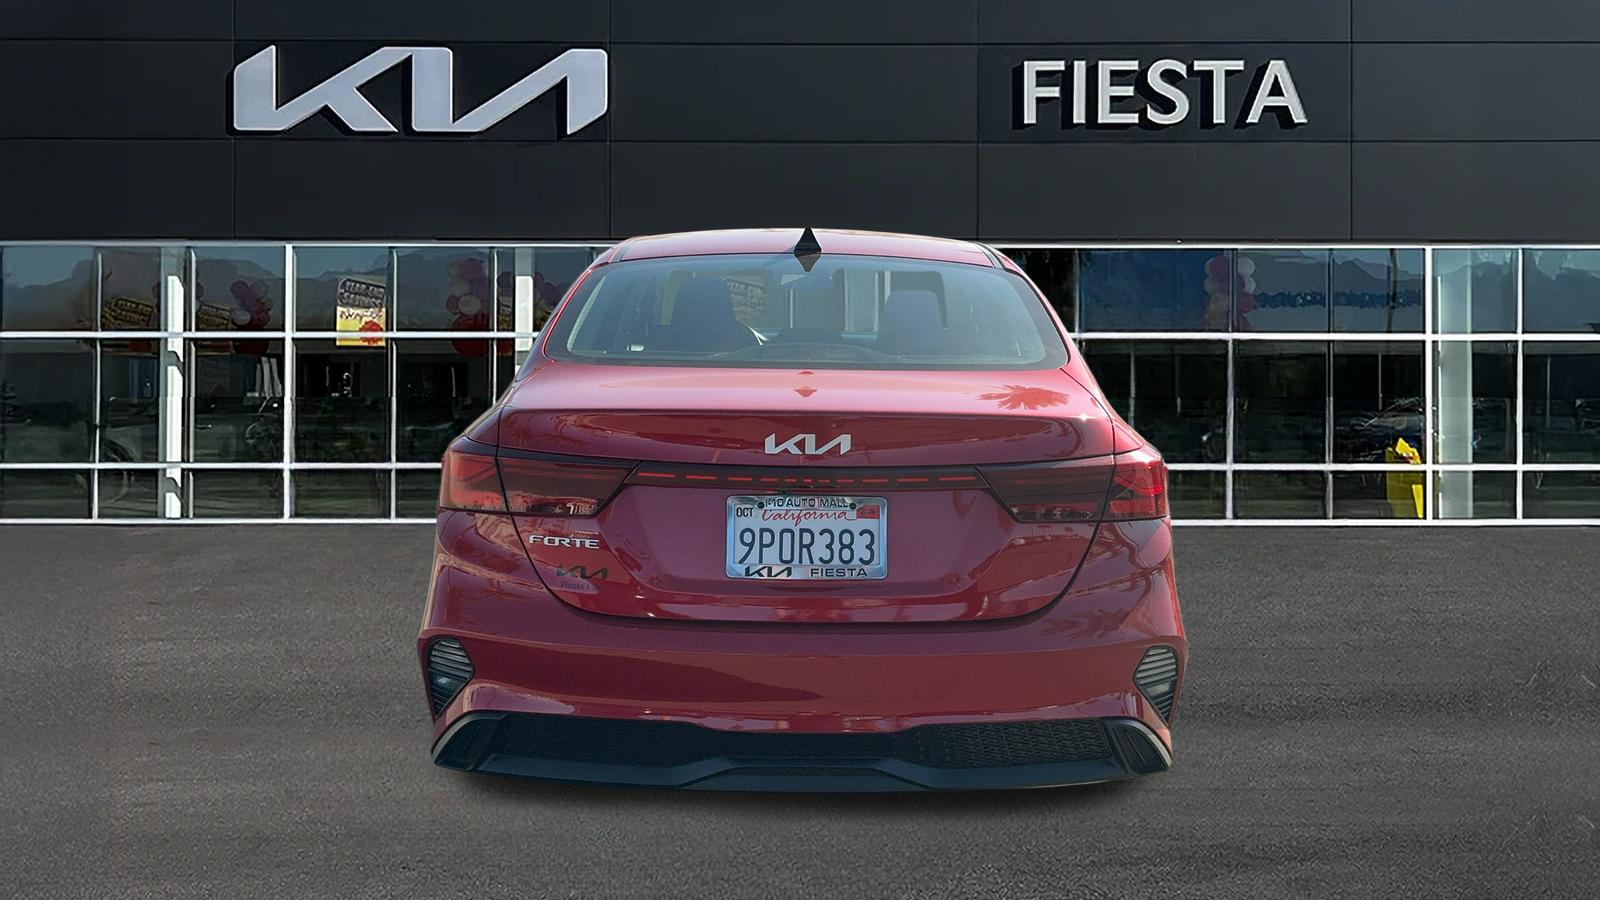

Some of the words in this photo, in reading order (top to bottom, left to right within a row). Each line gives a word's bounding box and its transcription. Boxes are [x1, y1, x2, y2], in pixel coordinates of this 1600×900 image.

[233, 44, 608, 136] KIA
[1023, 58, 1309, 125] FIESTA
[764, 433, 852, 455] KIA
[784, 498, 816, 508] AUTO
[819, 498, 849, 508] MALL
[736, 507, 754, 517] OCT
[762, 509, 857, 527] California
[528, 534, 600, 549] FORTE
[810, 567, 868, 577] FIESTA
